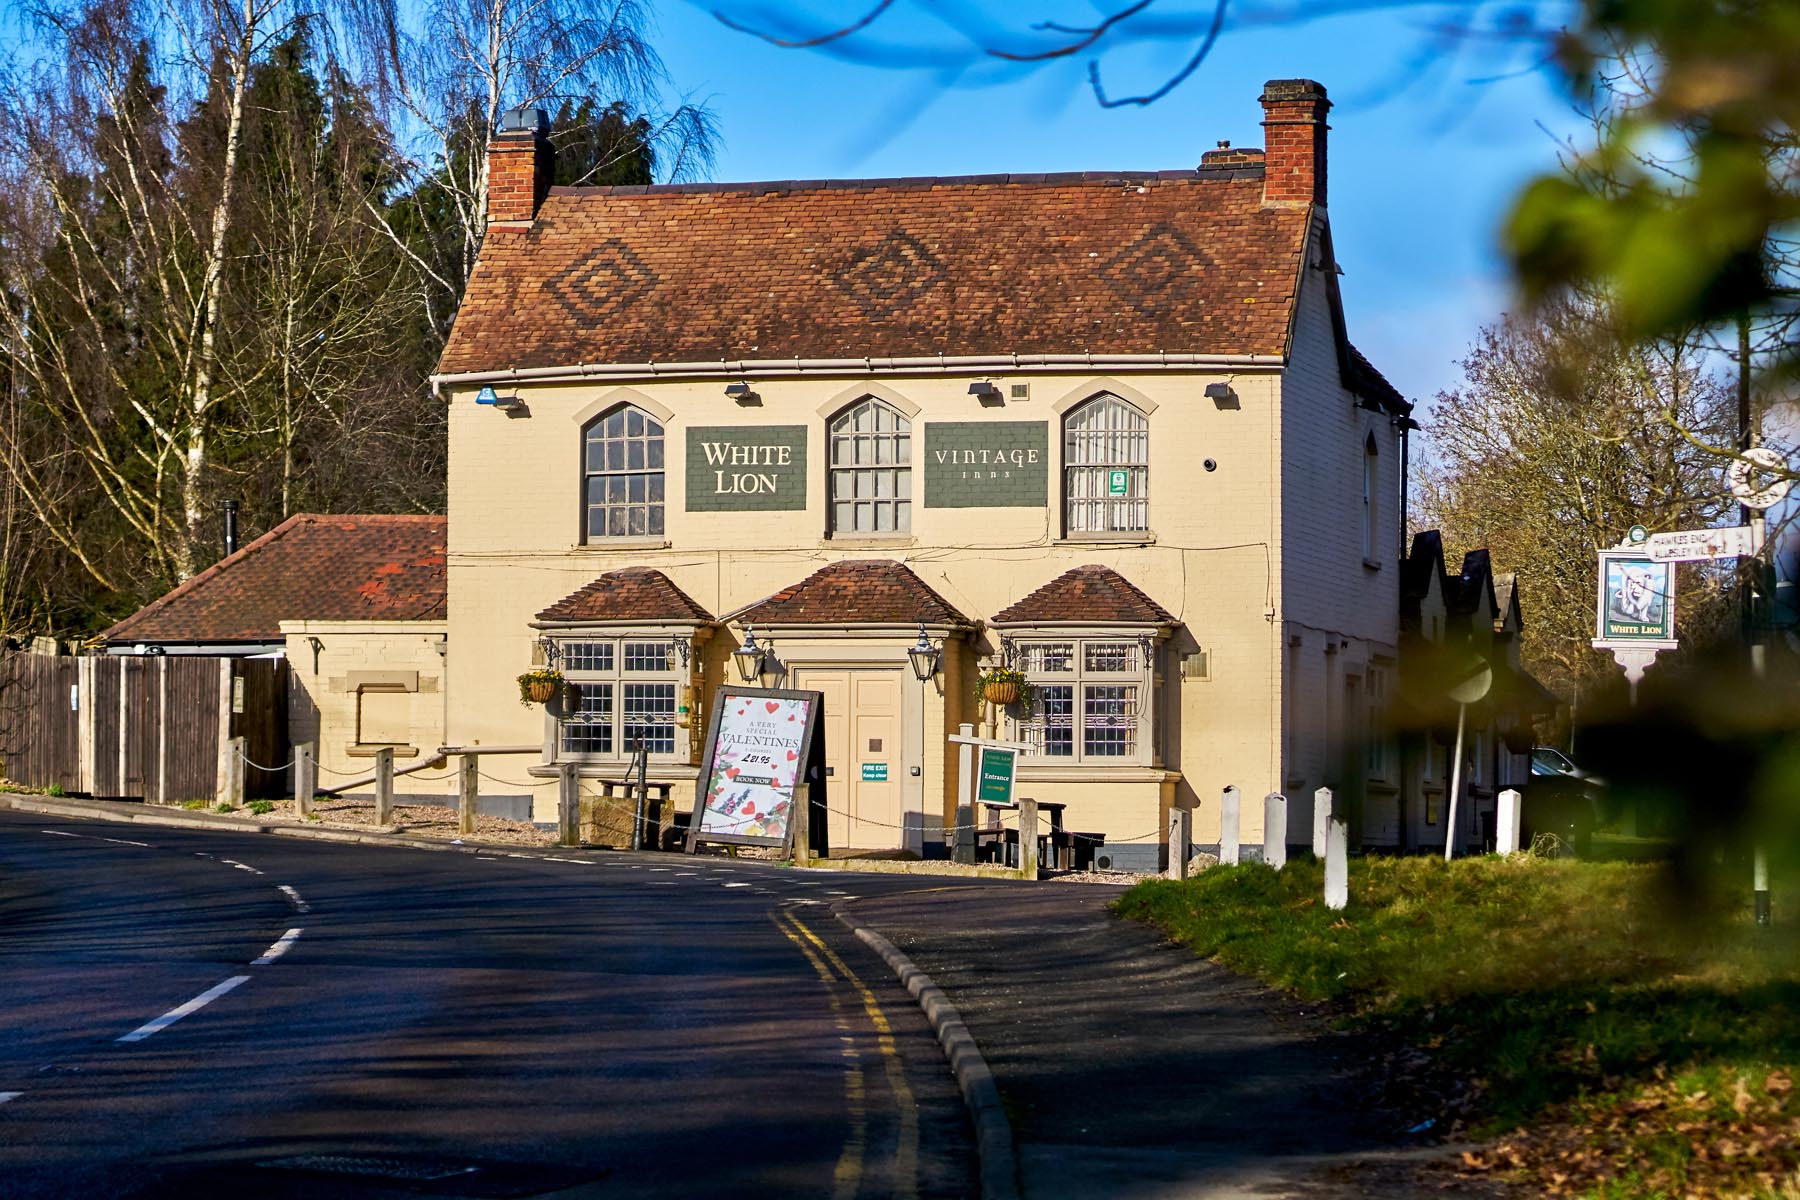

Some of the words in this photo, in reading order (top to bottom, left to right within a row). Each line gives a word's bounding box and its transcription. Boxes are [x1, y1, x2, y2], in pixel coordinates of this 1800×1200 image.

[701, 442, 792, 466] WHITE
[935, 449, 1039, 467] VINTAGE
[714, 470, 778, 494] LION
[1610, 624, 1639, 634] WHITE
[1641, 625, 1662, 635] LION
[757, 721, 777, 729] VERY
[746, 728, 777, 736] SPECIAL
[722, 733, 799, 748] VALENTINES
[736, 776, 754, 784] BOOK
[984, 773, 1010, 781] Entrance
